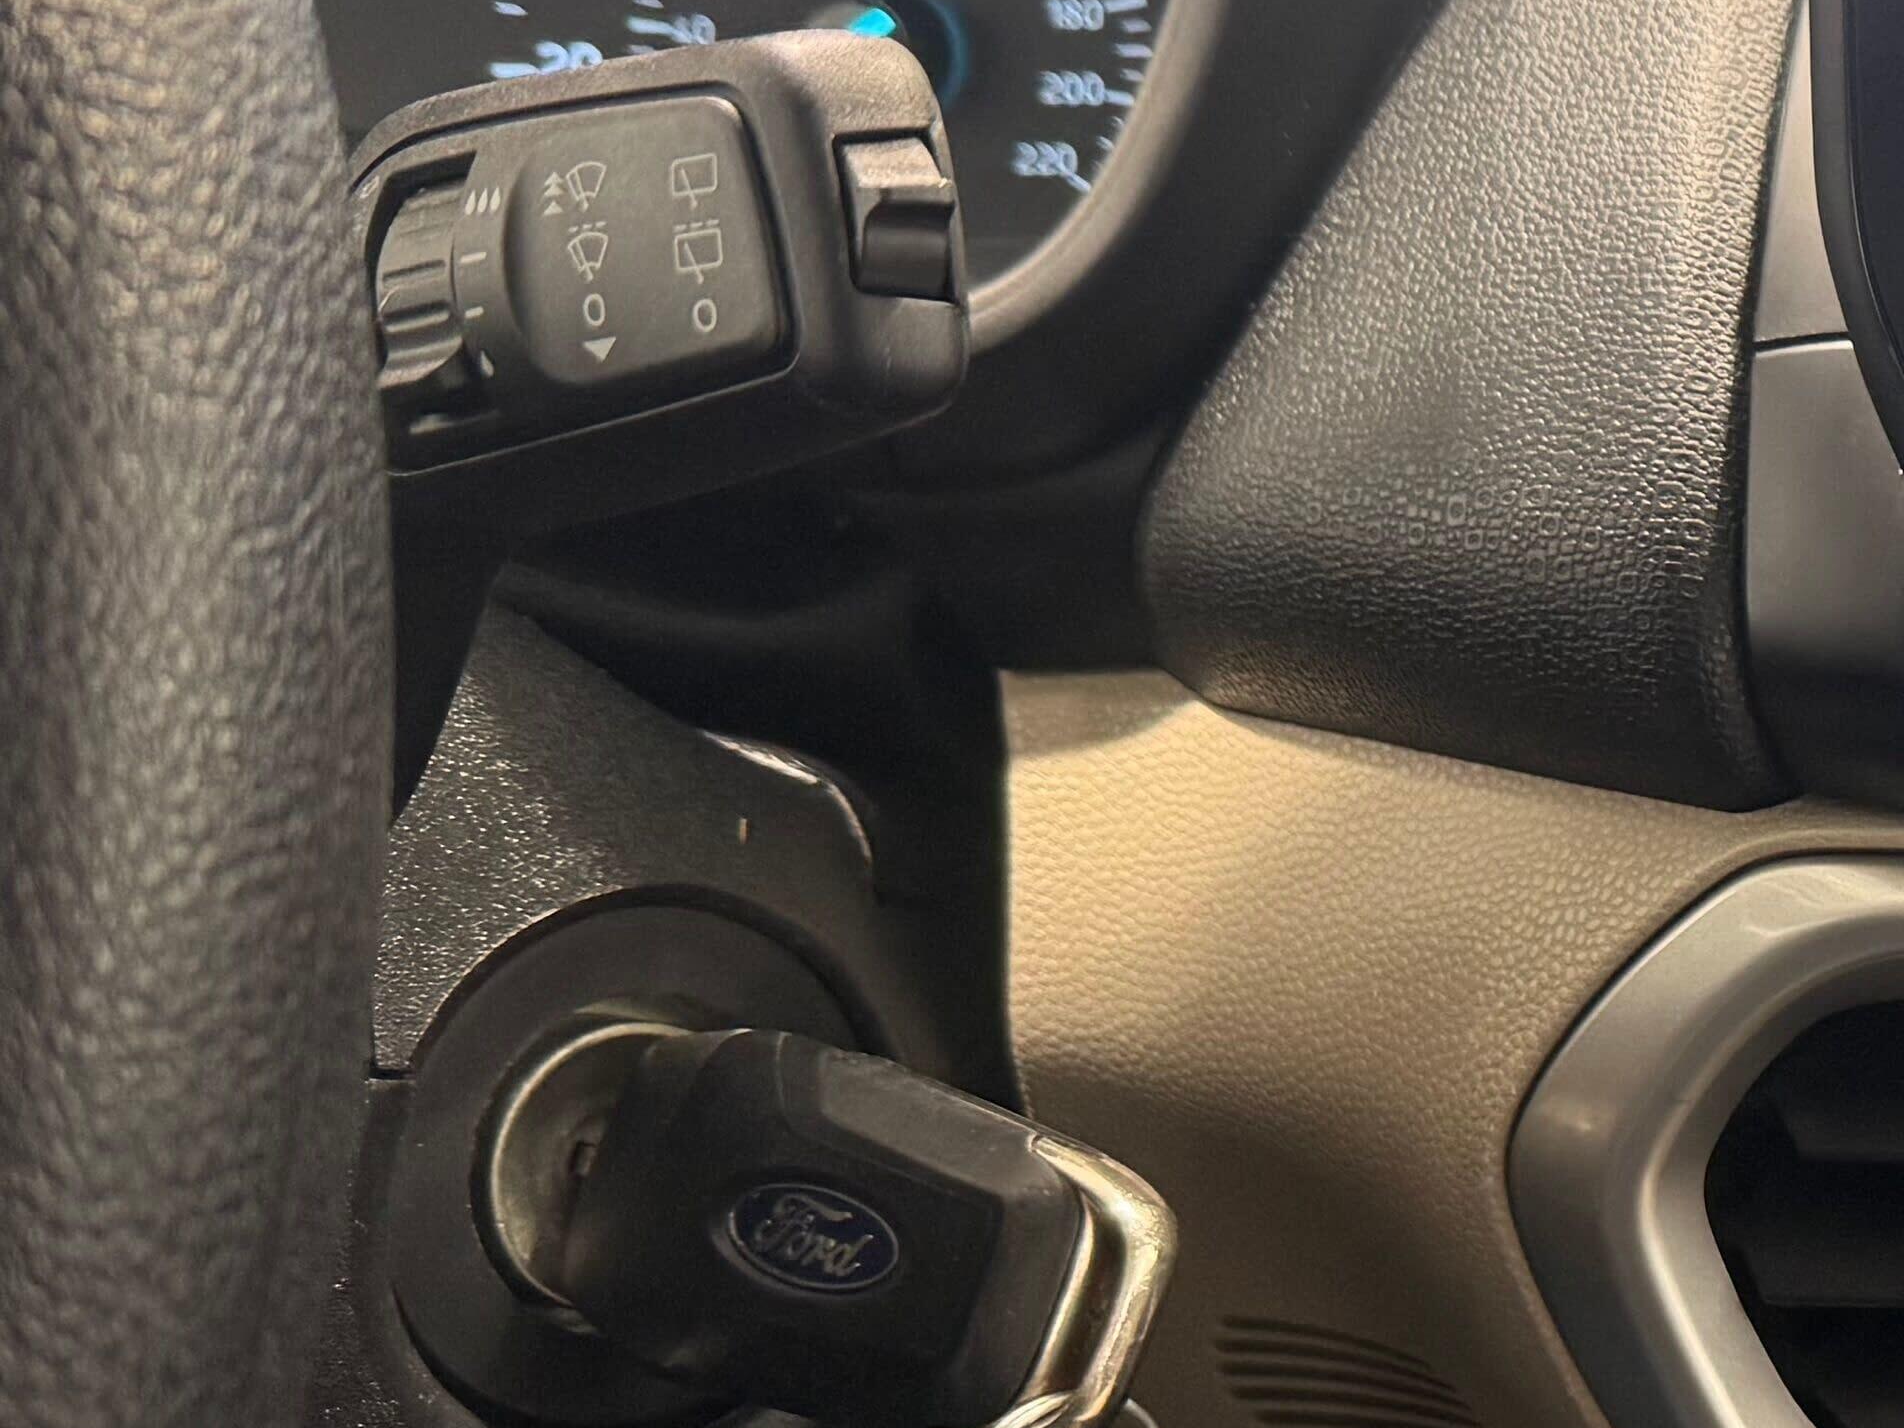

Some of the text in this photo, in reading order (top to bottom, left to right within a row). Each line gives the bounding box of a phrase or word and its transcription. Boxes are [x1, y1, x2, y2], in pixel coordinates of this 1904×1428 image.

[1037, 71, 1105, 107] 200
[1012, 141, 1079, 177] 220
[754, 1193, 874, 1276] Ford
